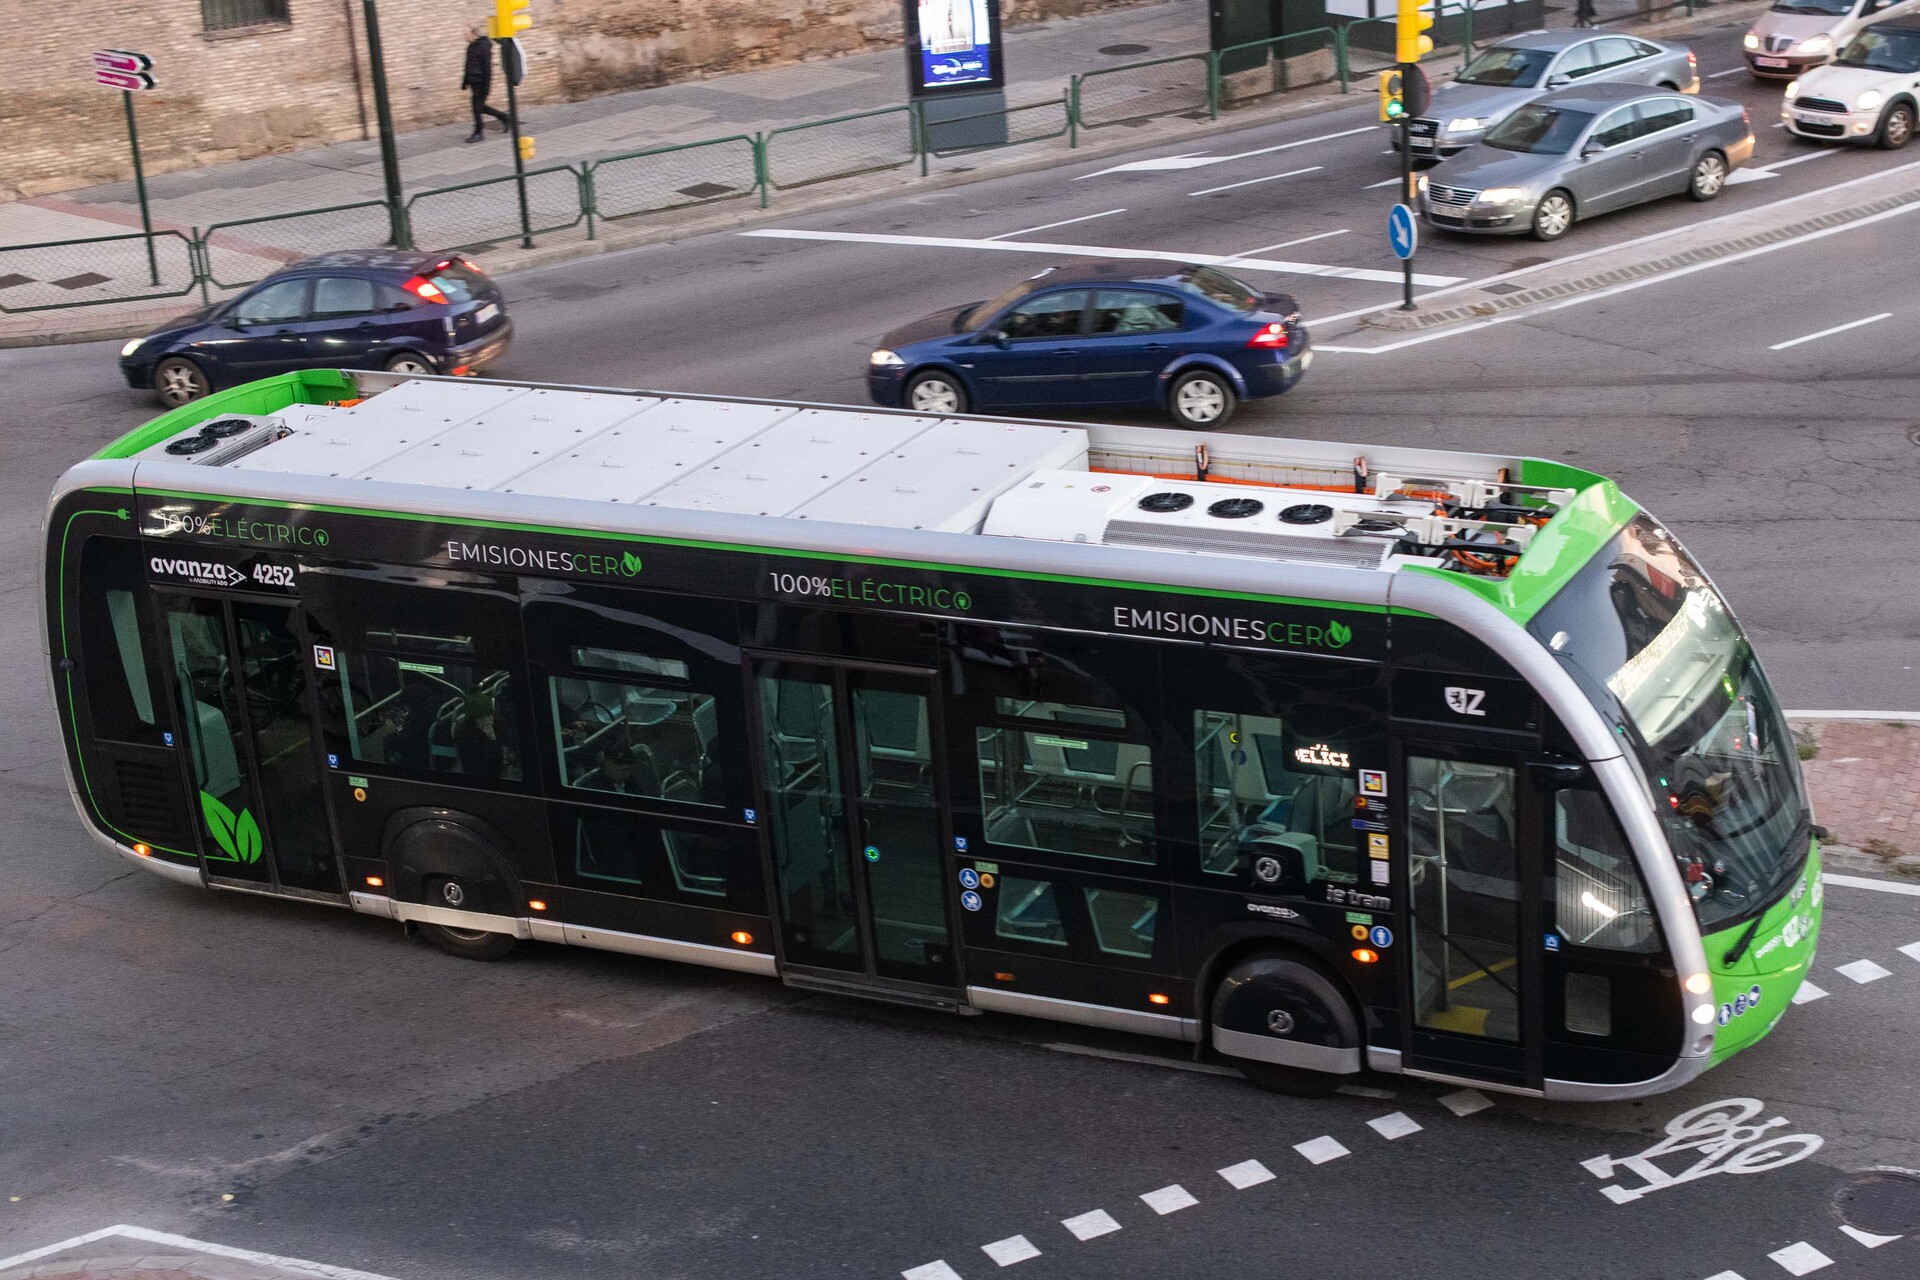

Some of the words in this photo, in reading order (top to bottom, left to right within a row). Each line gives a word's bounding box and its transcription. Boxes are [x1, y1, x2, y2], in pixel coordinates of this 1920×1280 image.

[150, 556, 228, 580] avanza
[253, 563, 296, 587] 4252
[194, 577, 217, 586] MOBILITY
